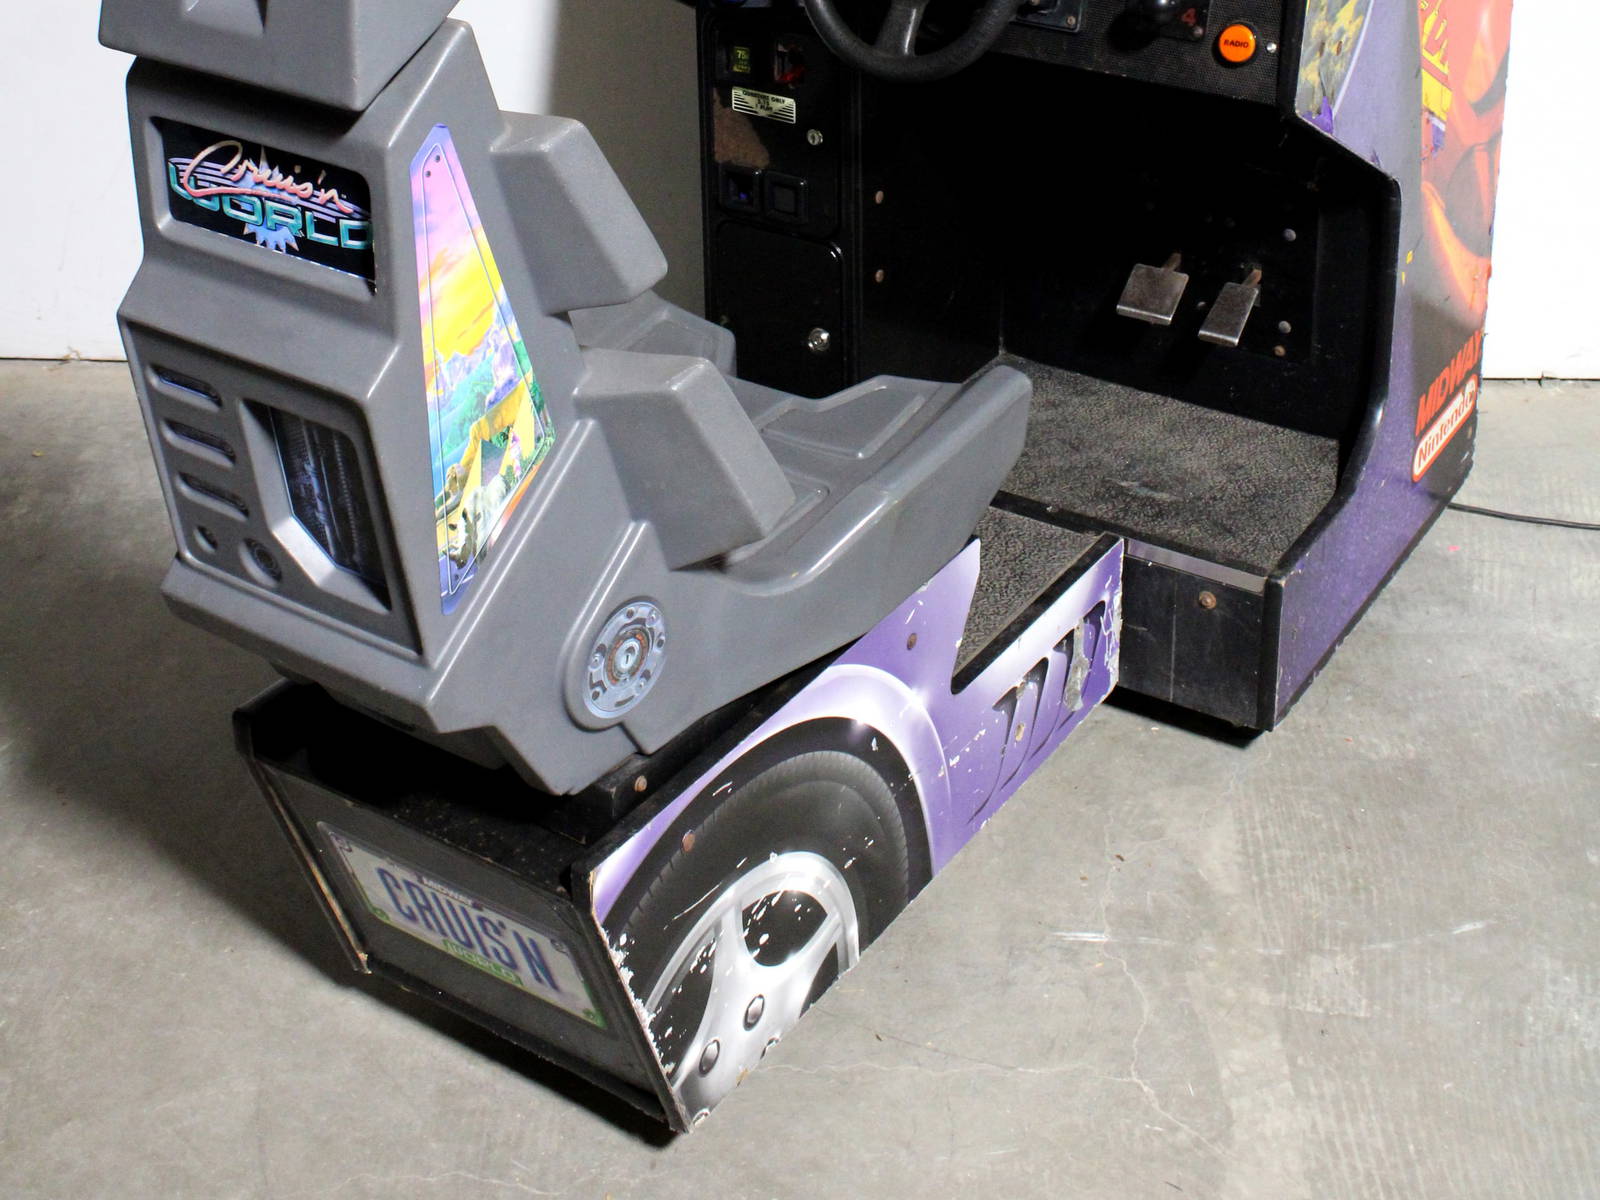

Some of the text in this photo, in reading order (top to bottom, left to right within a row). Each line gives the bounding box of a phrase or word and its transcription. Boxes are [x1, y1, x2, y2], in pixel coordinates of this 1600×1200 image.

[1181, 8, 1197, 26] 4
[1223, 39, 1249, 49] RADIO
[168, 161, 374, 250] WORLD
[1414, 329, 1482, 437] MIDWAY
[1416, 385, 1475, 470] Nintendo
[375, 866, 561, 993] CRUIS'N
